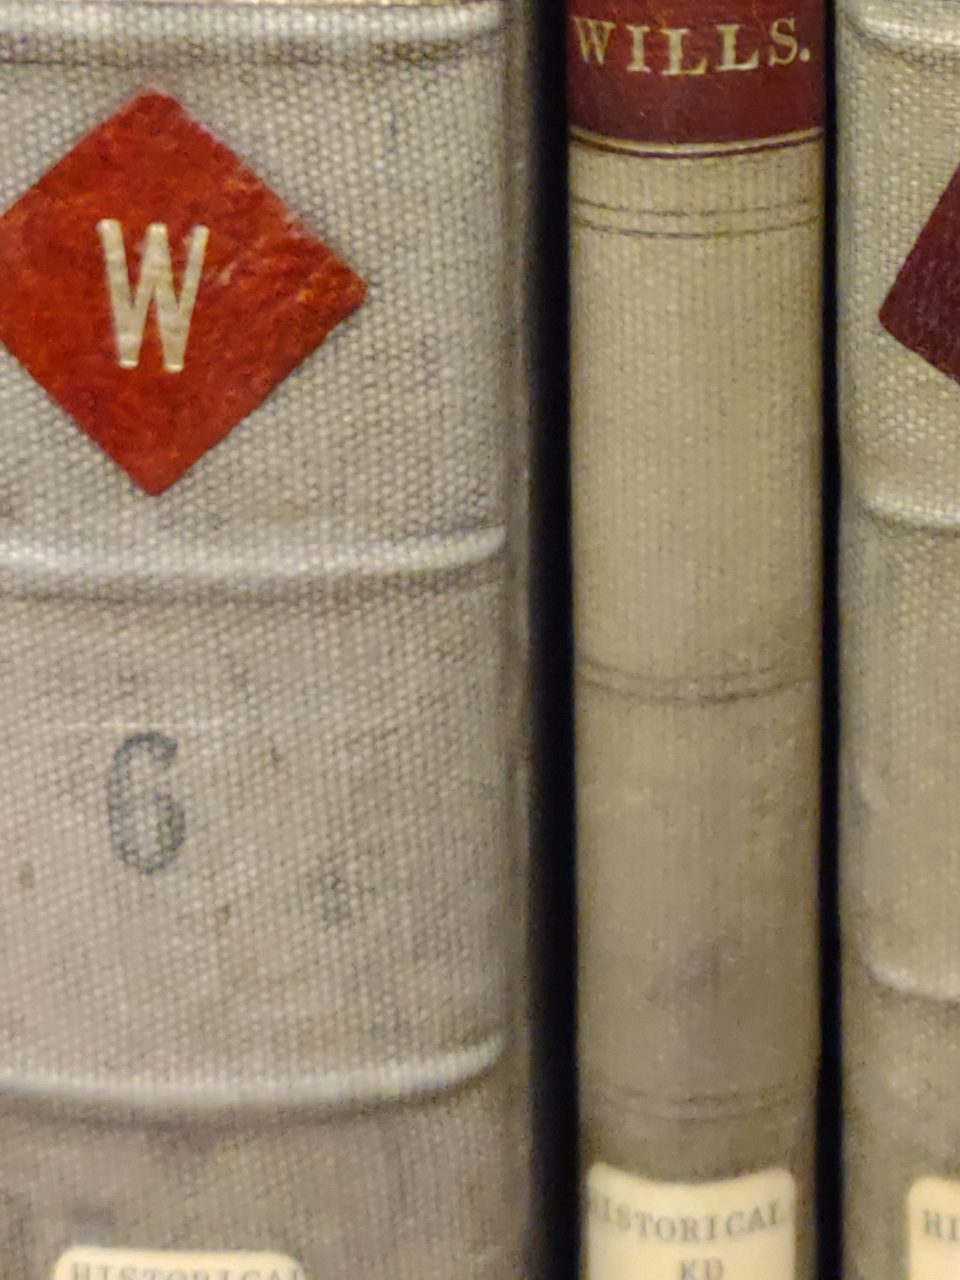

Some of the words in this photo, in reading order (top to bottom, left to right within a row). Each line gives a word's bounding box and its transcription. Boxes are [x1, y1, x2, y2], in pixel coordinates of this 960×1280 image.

[574, 16, 810, 77] WILLS.
[96, 219, 209, 373] W
[106, 730, 186, 876] 6
